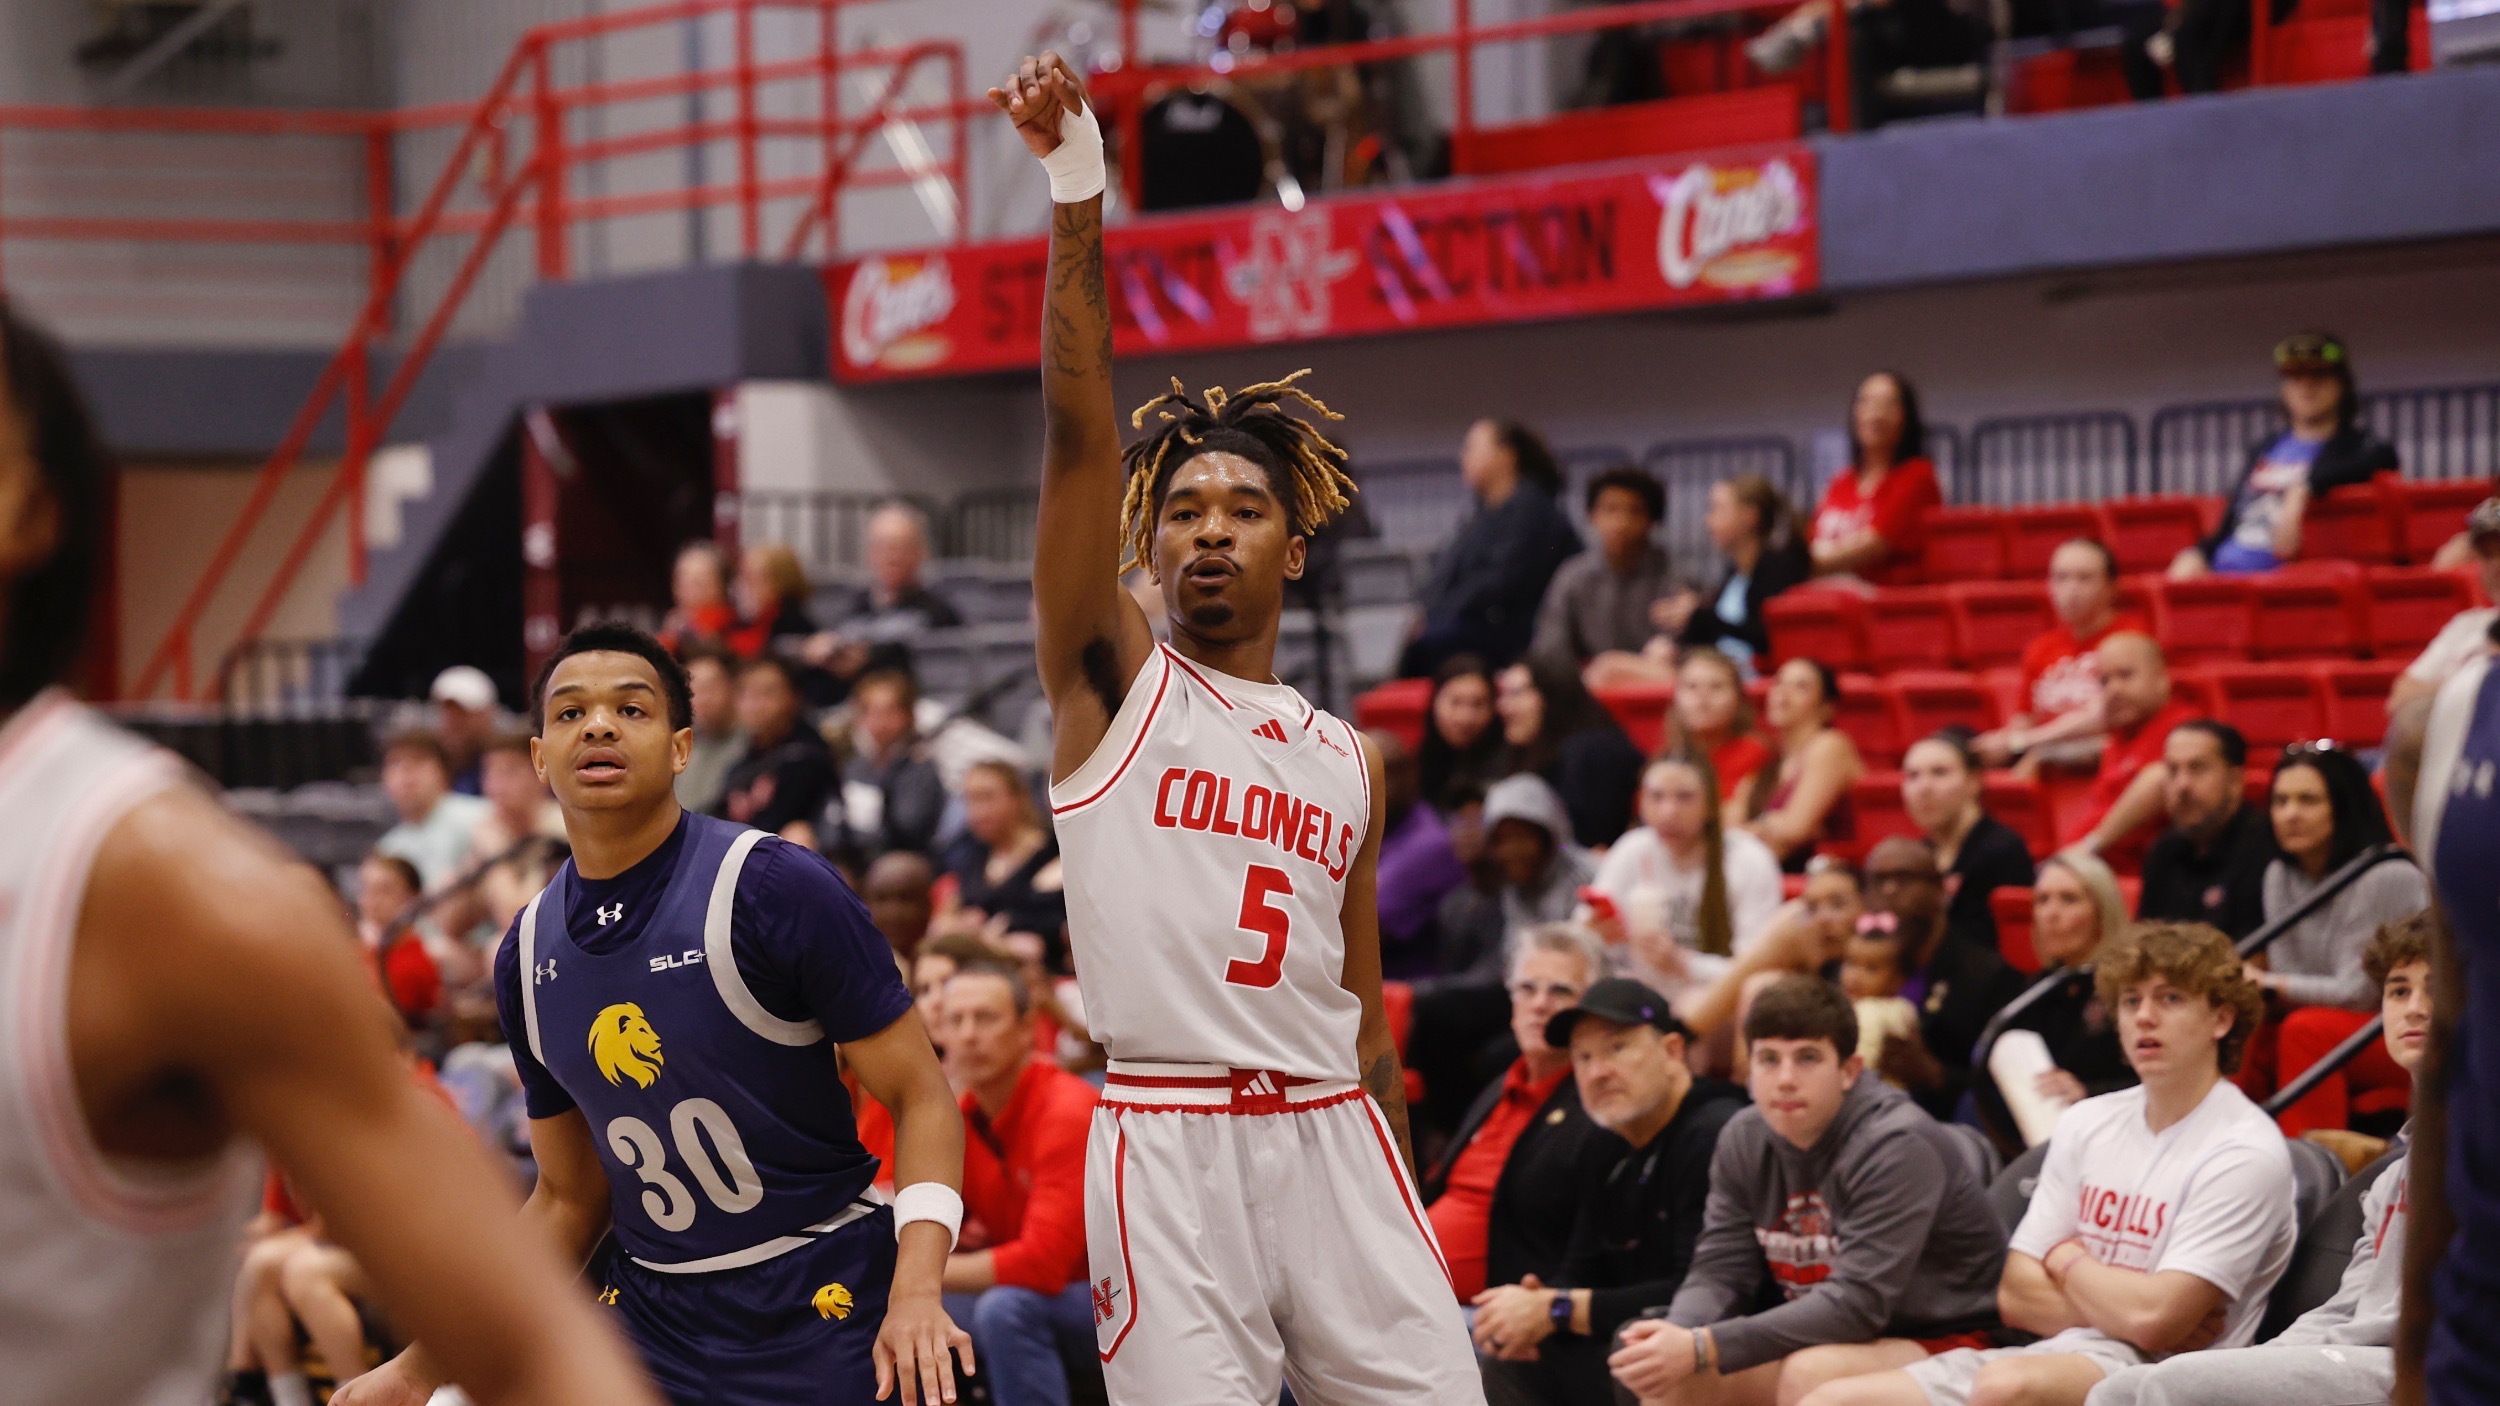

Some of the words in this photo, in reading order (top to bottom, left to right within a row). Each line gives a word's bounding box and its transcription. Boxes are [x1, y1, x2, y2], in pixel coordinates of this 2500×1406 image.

[1366, 202, 1617, 303] SECTION
[1153, 766, 1354, 883] COLONELS
[649, 949, 705, 973] SLC
[1223, 861, 1295, 990] 5
[606, 1097, 764, 1233] 30
